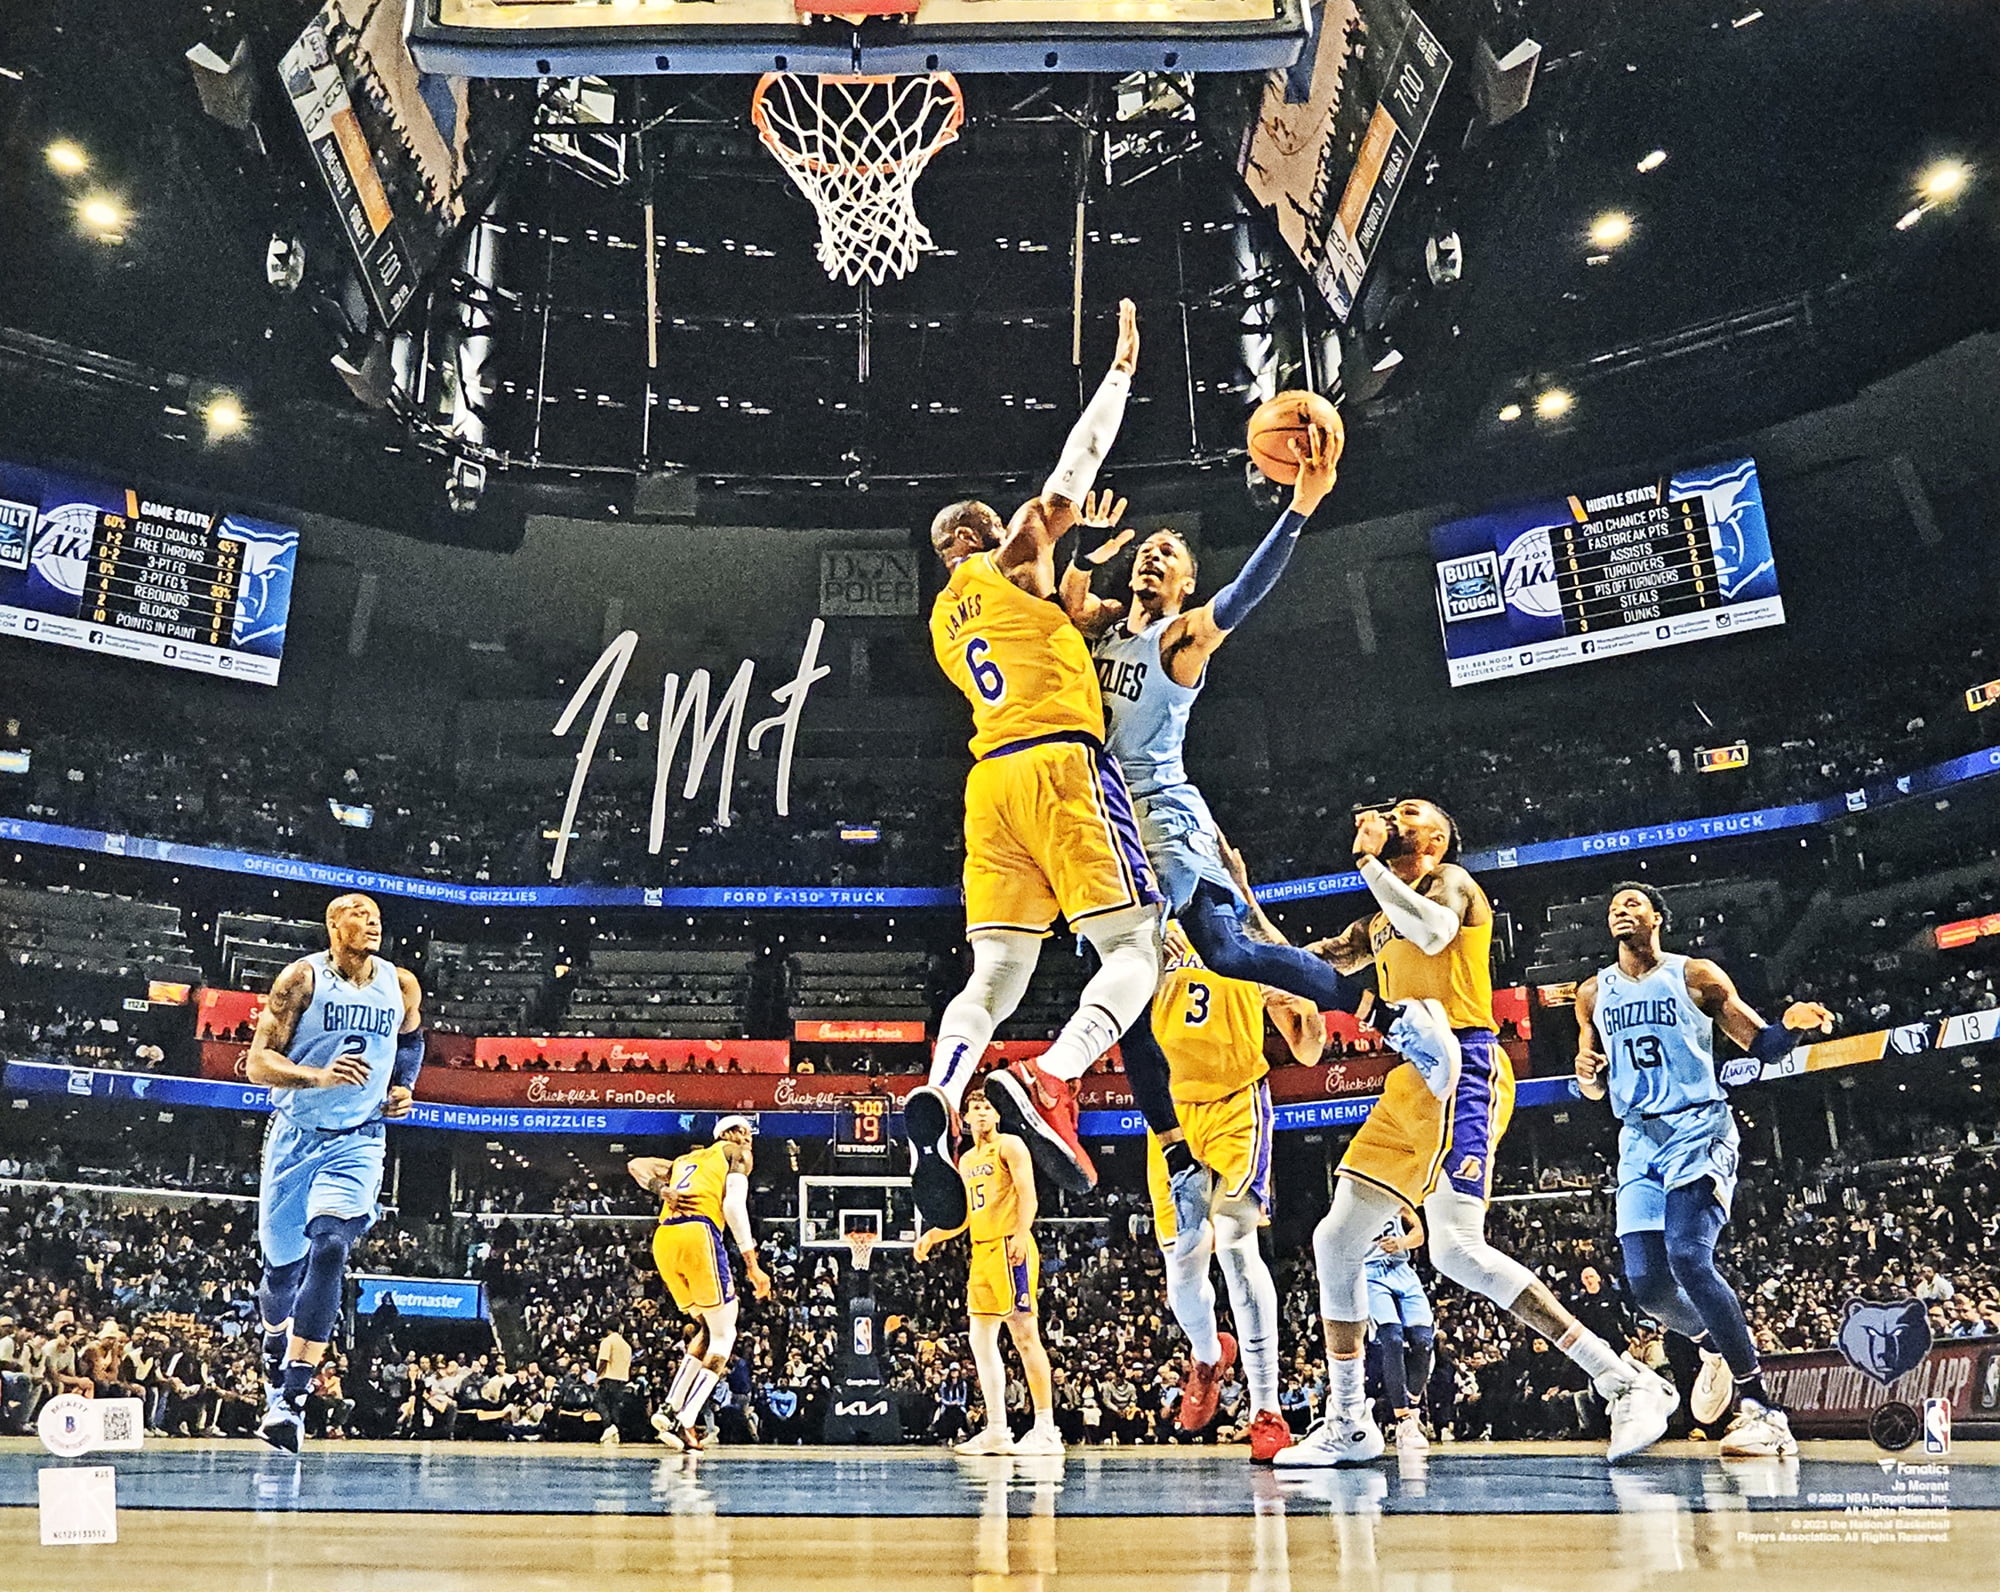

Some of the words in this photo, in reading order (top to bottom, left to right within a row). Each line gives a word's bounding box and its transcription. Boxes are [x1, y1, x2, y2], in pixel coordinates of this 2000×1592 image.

[1394, 64, 1424, 116] 7:00
[376, 241, 402, 286] 7:00
[140, 501, 174, 520] GAME
[175, 508, 210, 528] STATS
[1586, 492, 1624, 512] HUSTLE
[1625, 486, 1657, 506] STATS
[136, 522, 164, 538] FIELD
[165, 528, 198, 546] GOALS
[1564, 528, 1572, 540] 0
[1582, 522, 1603, 536] 2ND
[1605, 511, 1646, 532] CHANCE
[1648, 506, 1669, 520] PTS
[1682, 502, 1690, 514] 4
[1567, 544, 1574, 556] 2
[1588, 528, 1646, 550] FASTBREAK
[1648, 524, 1668, 537] PTS
[1684, 518, 1693, 530] 0
[106, 532, 123, 546] 1-2
[134, 538, 158, 554] FREE
[162, 543, 205, 562] THROWS
[217, 556, 236, 569] 2-2
[1526, 551, 1547, 560] LOS
[1610, 542, 1652, 562] ASSISTS
[1687, 533, 1696, 546] 3
[100, 546, 120, 560] 0-2
[148, 556, 172, 570] 3-PT
[172, 562, 186, 574] FG
[217, 572, 233, 584] 1-3
[139, 571, 162, 585] 3-PT
[164, 576, 178, 589] FG
[1444, 560, 1491, 584] BUILT
[1574, 574, 1579, 586] 1
[1603, 556, 1665, 580] TURNOVERS
[1690, 549, 1698, 562] 2
[100, 578, 108, 590] 4
[134, 585, 190, 607] REBOUNDS
[214, 602, 222, 614] 5
[1575, 589, 1583, 600] 4
[1594, 583, 1611, 596] PTS
[1612, 580, 1627, 594] OFF
[1629, 569, 1678, 590] TURNOVERS
[1692, 565, 1702, 577] 0
[1578, 604, 1584, 616] 1
[1620, 590, 1658, 608] STEALS
[1696, 580, 1704, 592] 0
[98, 594, 106, 606] 2
[138, 602, 180, 621] BLOCKS
[212, 617, 220, 628] 0
[944, 593, 982, 640] JAMES
[1450, 593, 1496, 614] TOUGH
[1580, 620, 1588, 632] 3
[1624, 606, 1660, 624] DUNKS
[1700, 596, 1706, 608] 1
[94, 610, 106, 622] 10
[116, 614, 152, 632] POINTS
[154, 619, 165, 634] IN
[167, 624, 197, 640] PAINT
[966, 637, 1004, 702] 6
[1582, 835, 1630, 852] FORD
[1701, 814, 1764, 834] TRUCK
[244, 858, 307, 876] OFFICIAL
[309, 868, 354, 884] TRUCK
[357, 876, 375, 886] OF
[378, 878, 404, 891] THE
[407, 883, 466, 900] MEMPHIS
[470, 891, 538, 902] GRIZZLIES
[724, 892, 767, 902] FORD
[830, 892, 885, 902] TRUCK
[1255, 882, 1316, 900] MEMPHIS
[1318, 876, 1365, 890] GRIZZL
[1186, 982, 1210, 1023] 3
[1603, 997, 1676, 1036] GRIZZLIES
[324, 1002, 395, 1038] GRIZZLIES
[1962, 1016, 1981, 1042] 13
[1623, 1035, 1662, 1070] 13
[606, 1090, 676, 1104] FanDeck
[1284, 1110, 1316, 1123] THE
[1321, 1104, 1372, 1120] MEMP
[410, 1108, 439, 1122] THE
[444, 1111, 519, 1126] MEMPHIS
[524, 1115, 606, 1128] GRIZZLIES
[855, 1116, 878, 1142] 19
[676, 1164, 698, 1190] 2
[970, 1184, 985, 1211] 15
[1934, 1356, 1971, 1407] APP
[65, 1416, 76, 1431] B
